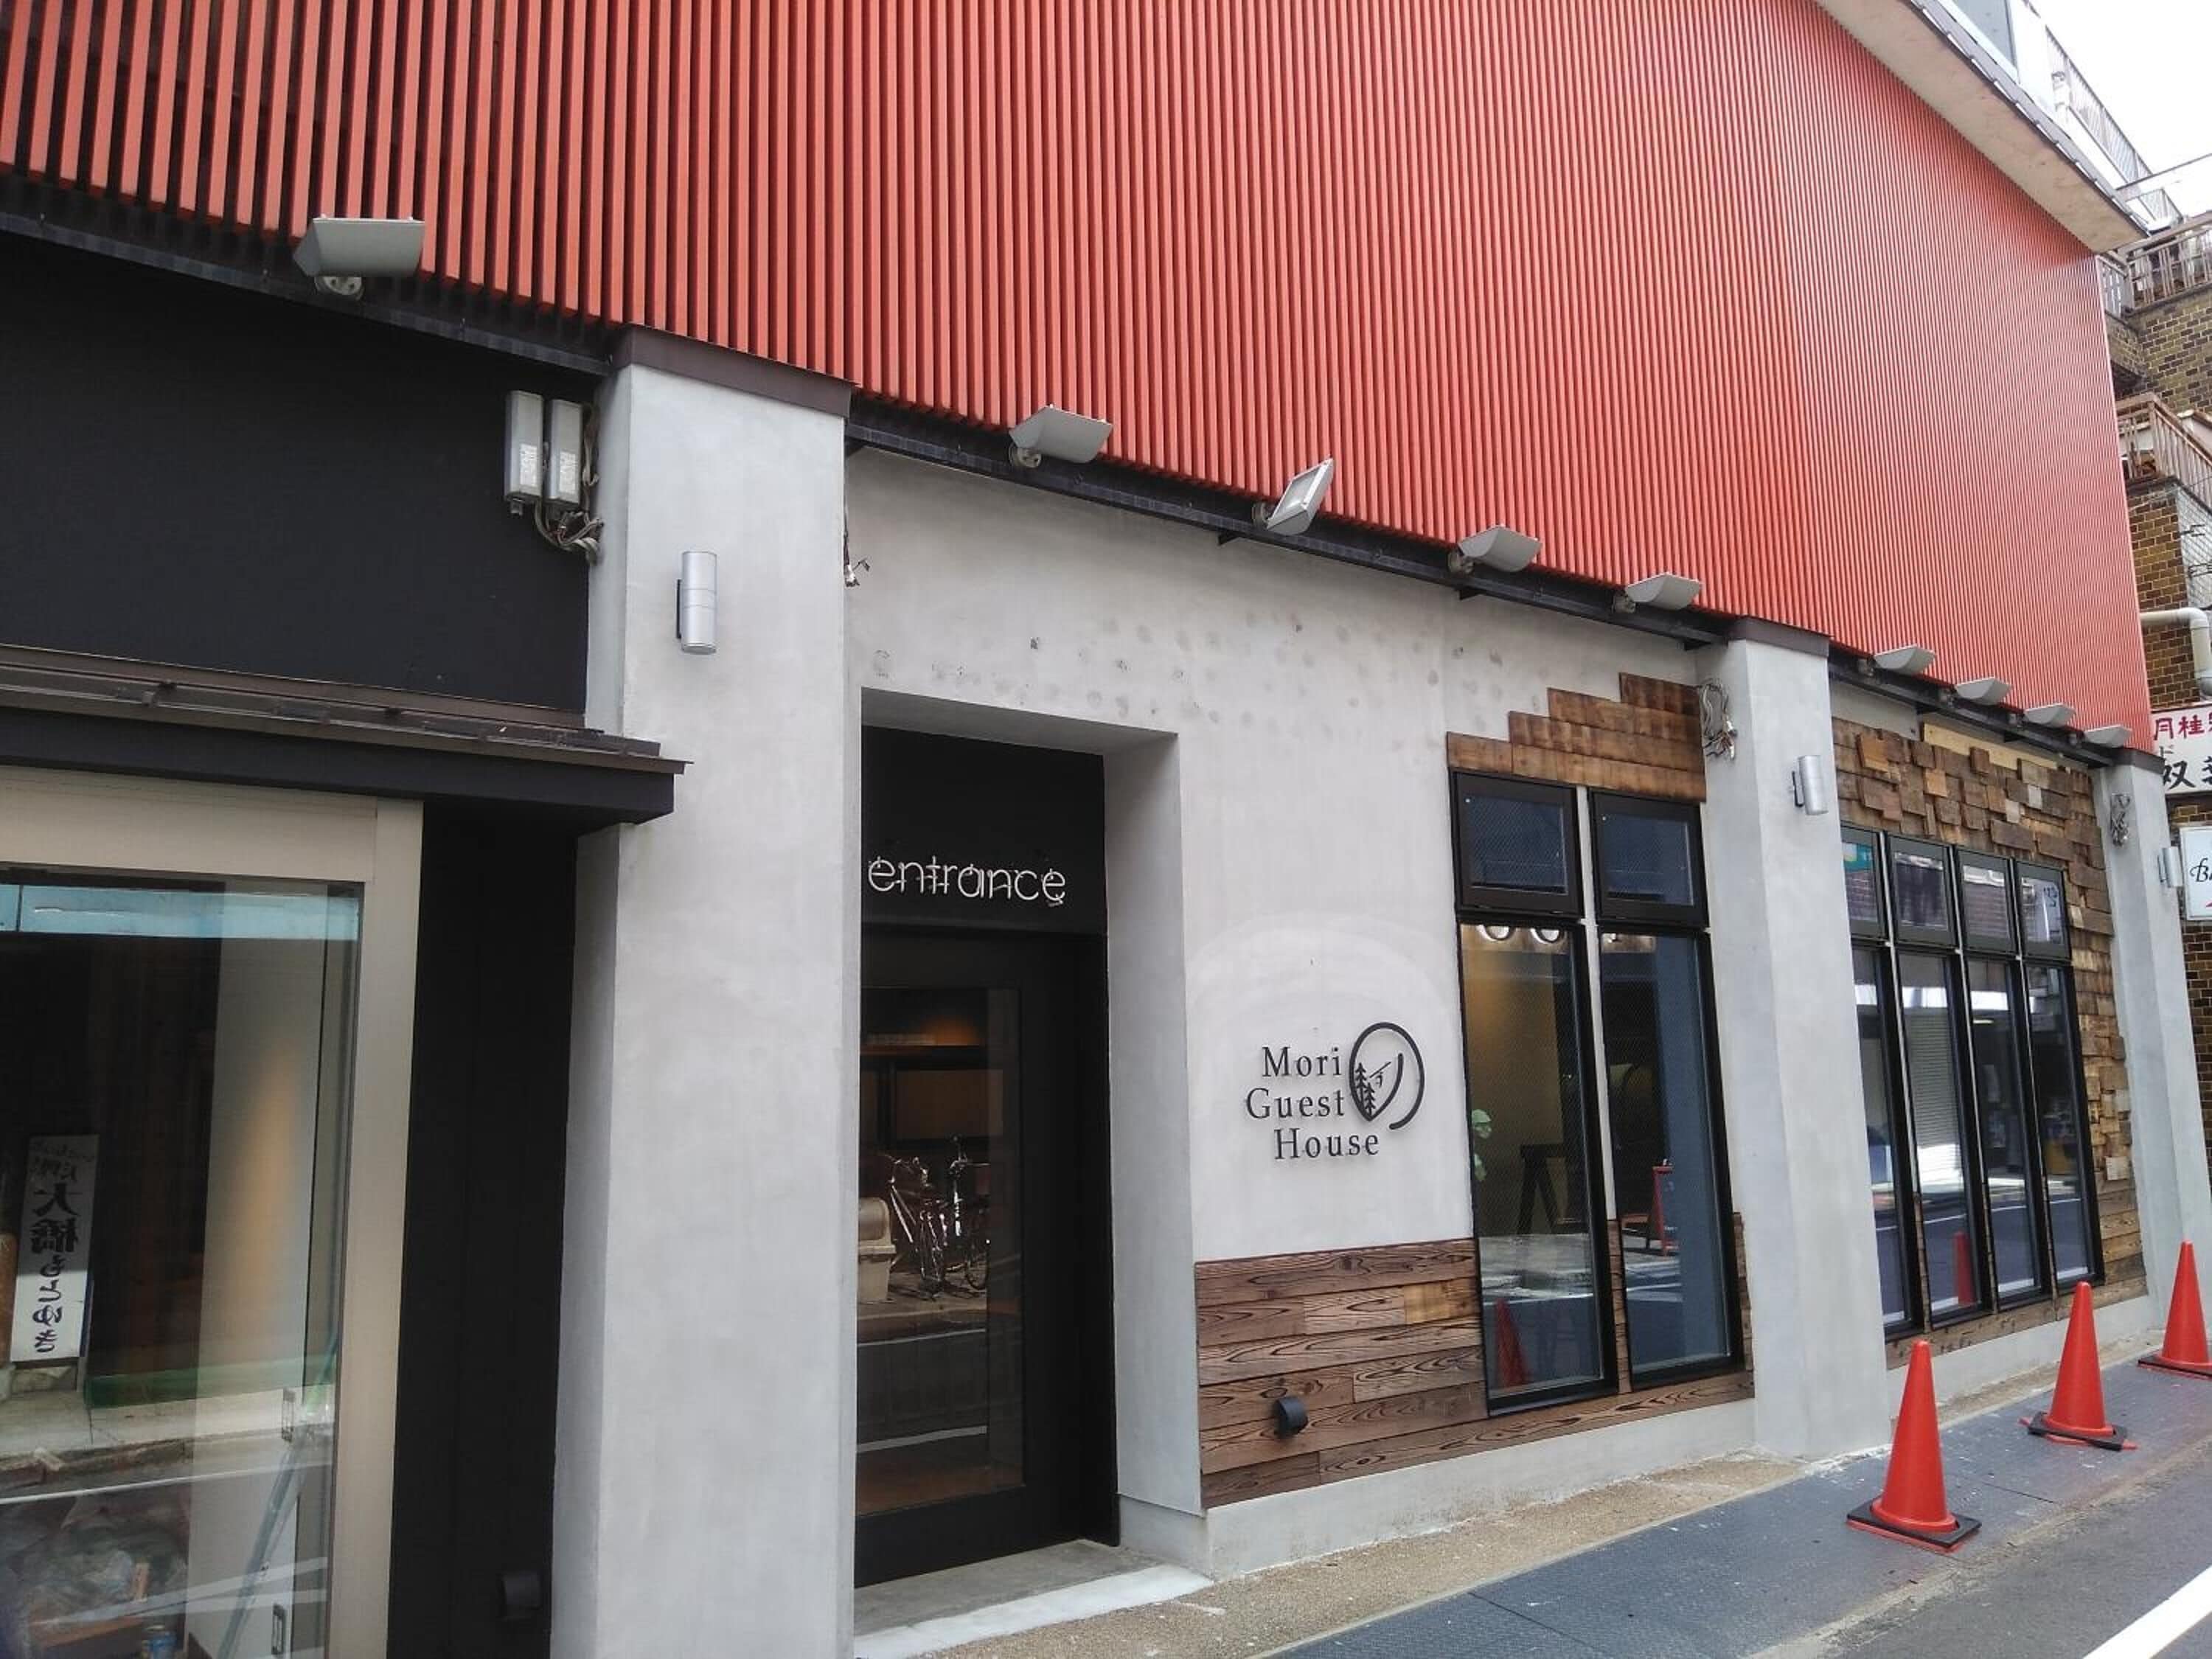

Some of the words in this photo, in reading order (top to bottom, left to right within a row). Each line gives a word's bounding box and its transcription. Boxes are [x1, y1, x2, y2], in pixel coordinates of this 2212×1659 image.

[2154, 712, 2212, 740] 月桂
[868, 855, 1066, 905] entrance
[2190, 858, 2212, 882] B
[1262, 1046, 1343, 1078] Mori
[1246, 1087, 1345, 1119] Guest
[1273, 1127, 1380, 1161] House
